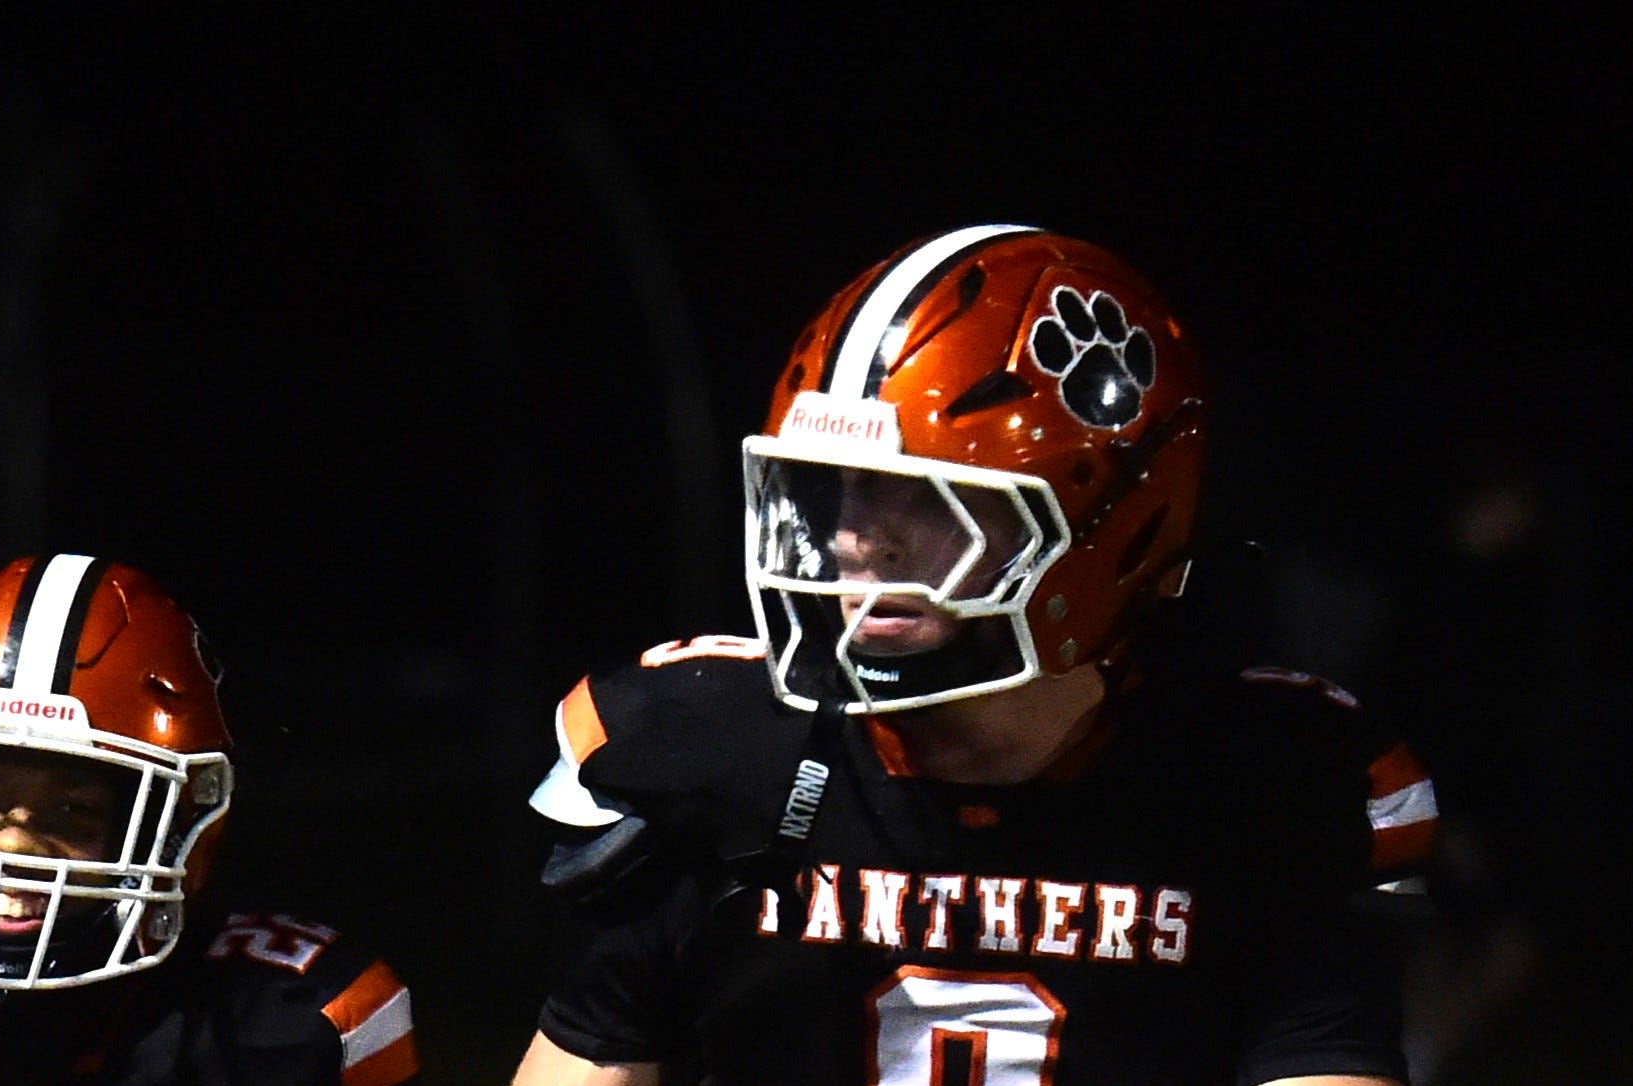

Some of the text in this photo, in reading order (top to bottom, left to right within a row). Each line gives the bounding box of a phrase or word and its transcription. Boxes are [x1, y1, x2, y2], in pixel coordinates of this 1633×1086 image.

[792, 408, 884, 441] Riddell
[777, 759, 830, 840] NXTRND
[757, 863, 1195, 964] ANTHERS
